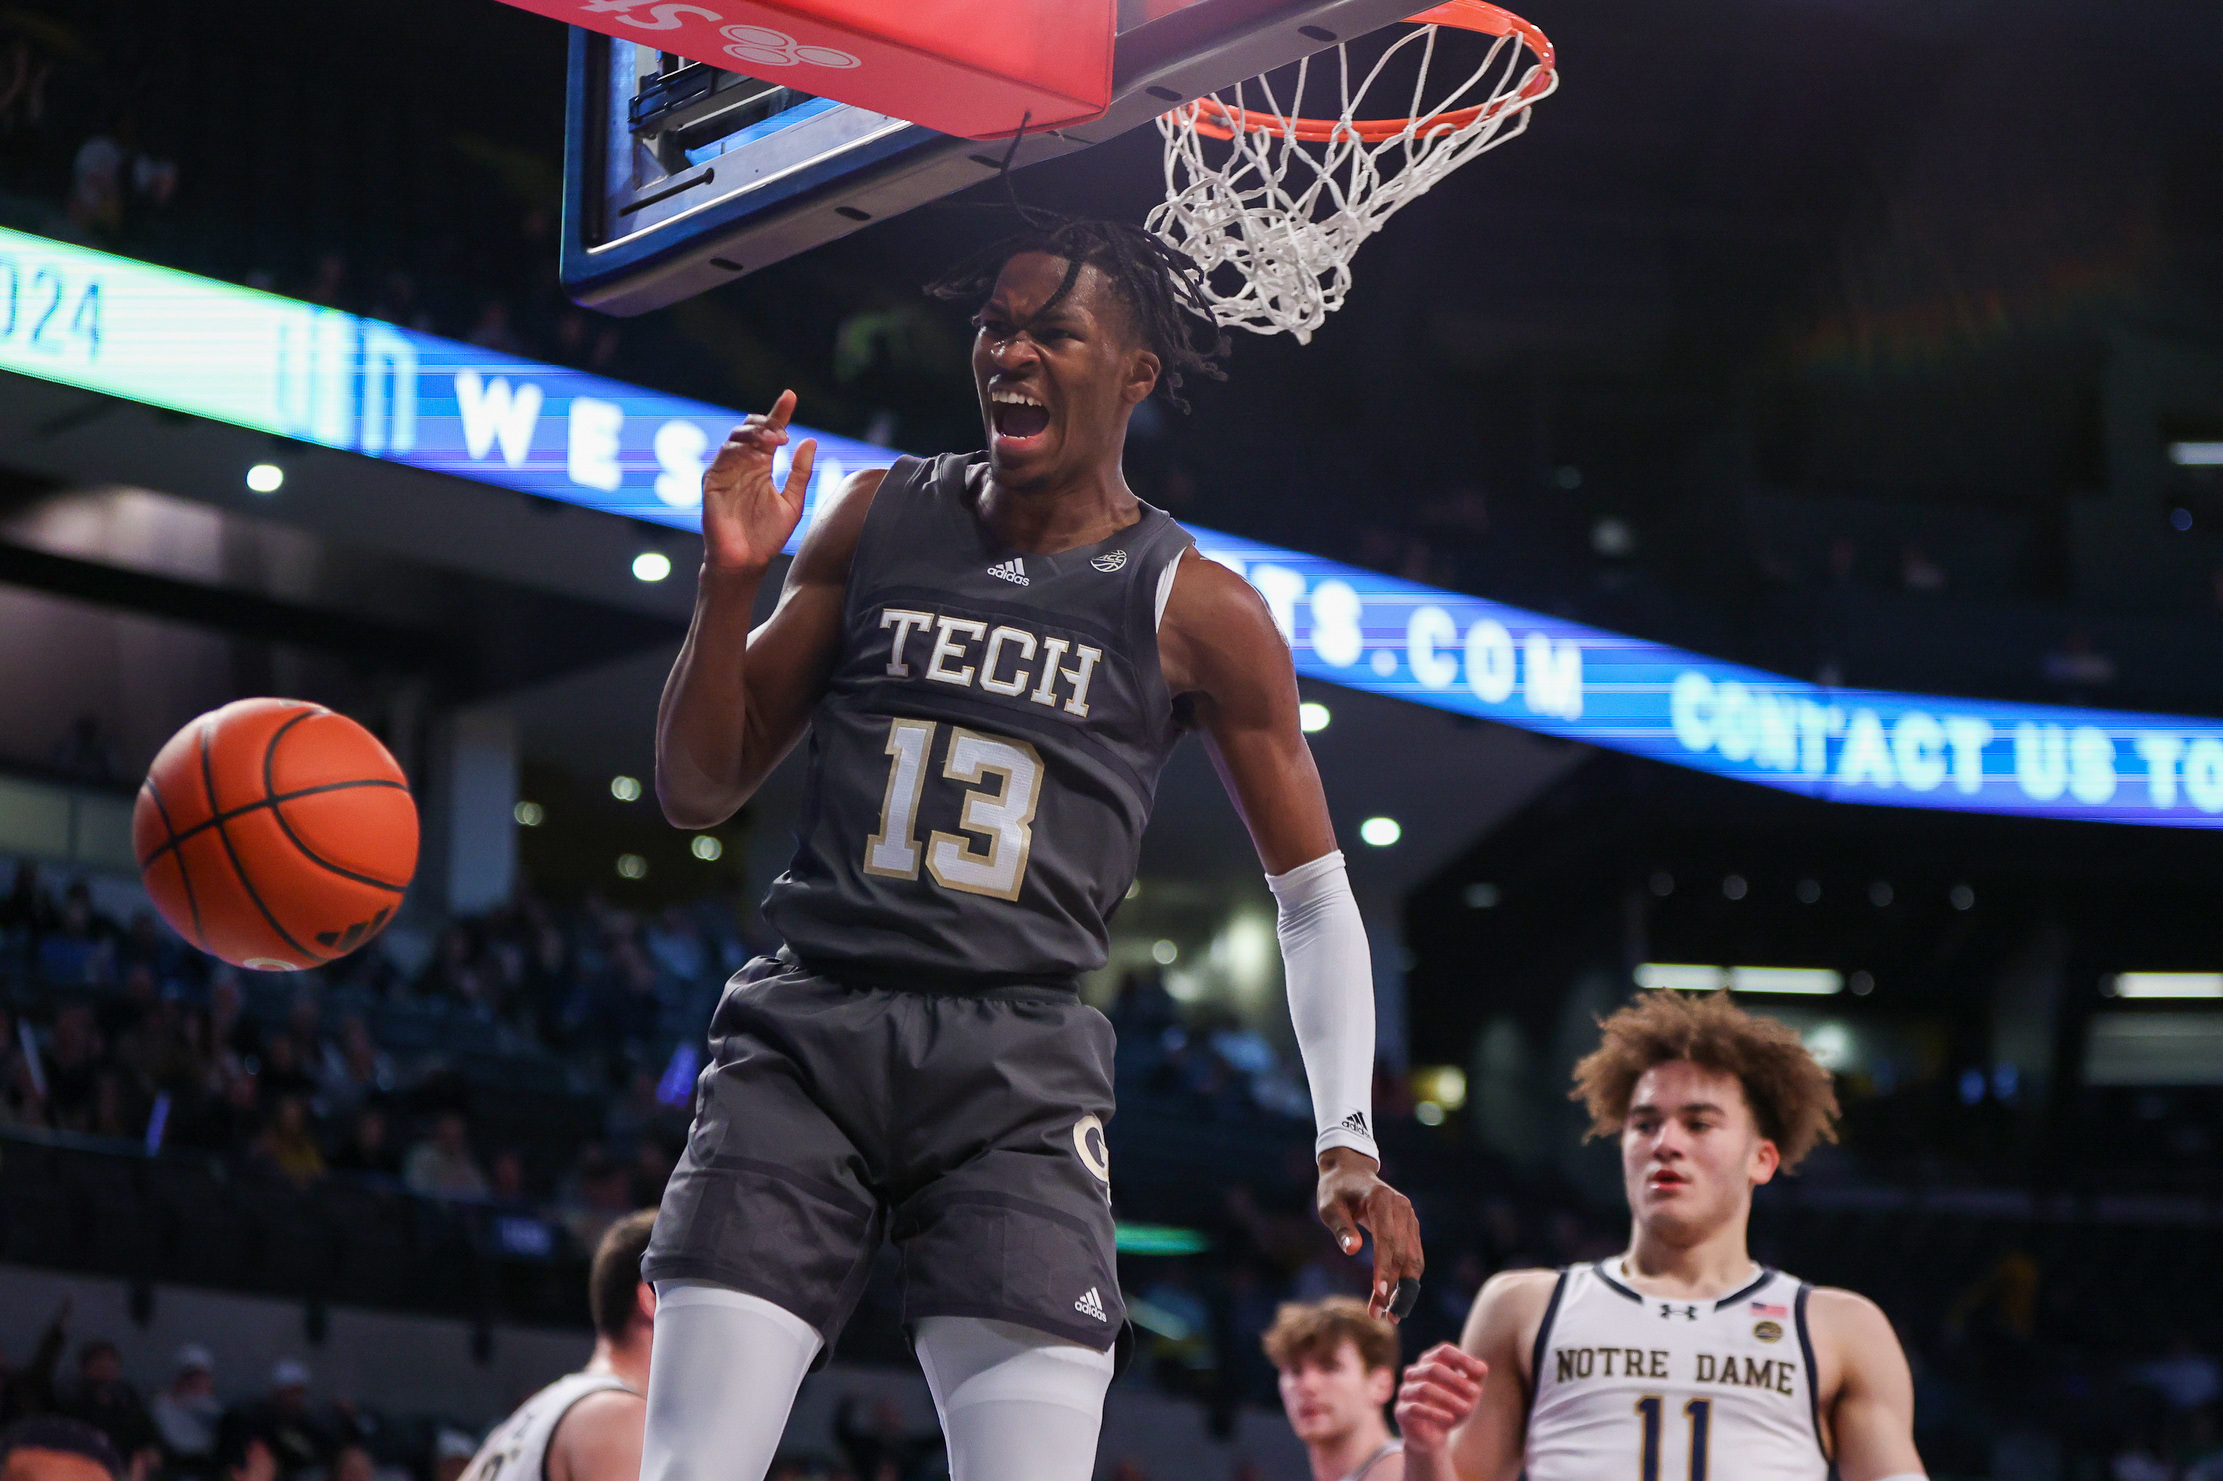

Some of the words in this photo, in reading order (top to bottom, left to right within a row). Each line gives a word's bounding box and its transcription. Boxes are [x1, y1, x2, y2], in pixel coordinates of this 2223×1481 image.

[986, 566, 1030, 587] adidas
[879, 607, 1102, 719] TECH
[1670, 672, 1993, 795] CONTACT
[2015, 720, 2117, 804] US
[2134, 737, 2223, 814] TO
[863, 717, 1046, 902] 13
[1074, 1299, 1107, 1323] adidas
[1555, 1346, 1669, 1384] NOTRE
[1696, 1353, 1796, 1396] DAME
[1635, 1394, 1711, 1481] 11
